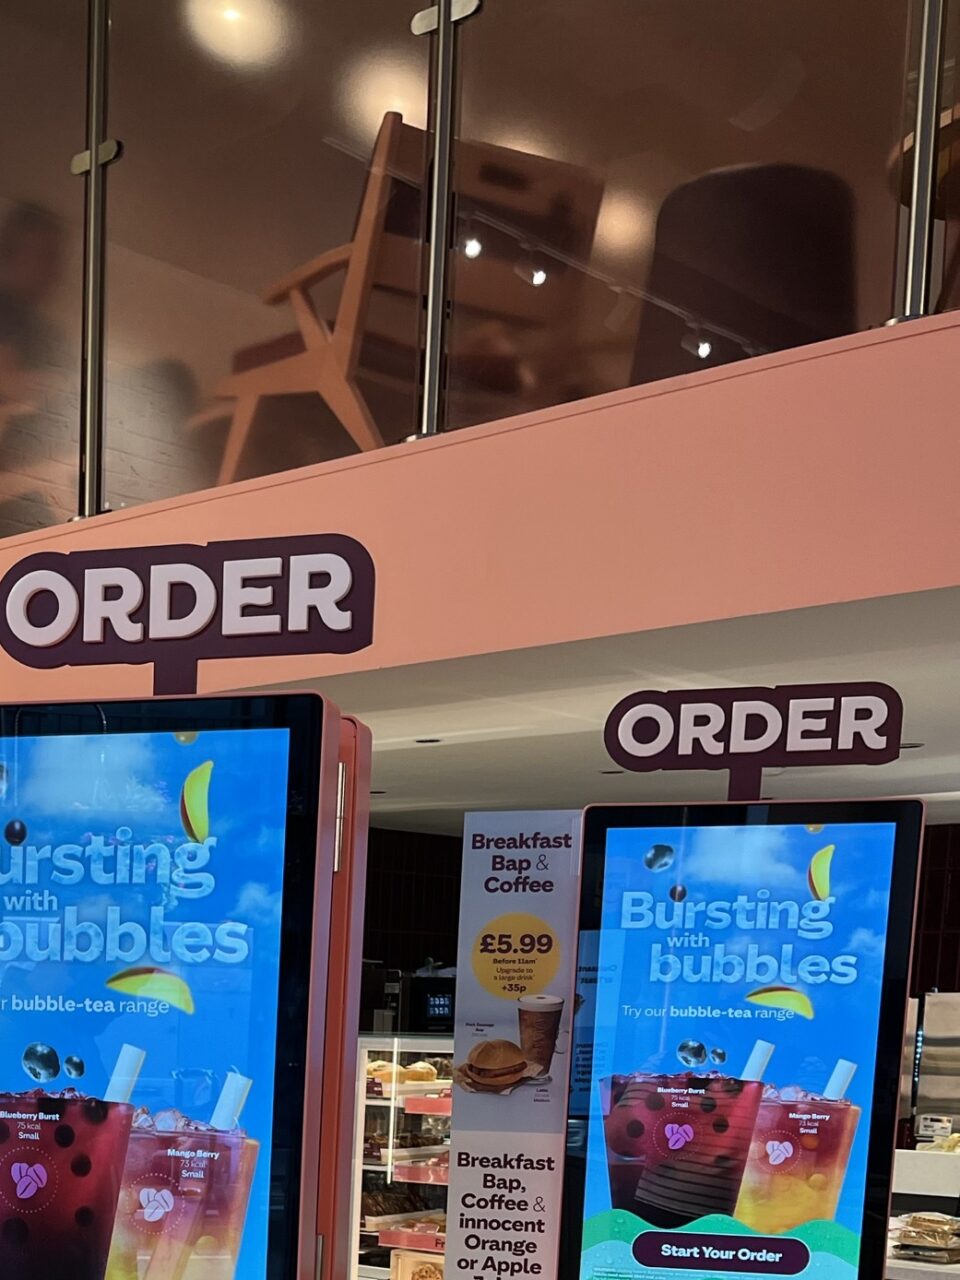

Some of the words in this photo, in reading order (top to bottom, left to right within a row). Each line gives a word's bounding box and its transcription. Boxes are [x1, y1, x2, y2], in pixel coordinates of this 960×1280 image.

[5, 552, 353, 648] ORDER
[617, 695, 889, 758] ORDER
[471, 832, 572, 850] Breakfast
[491, 855, 531, 874] Bap
[536, 854, 549, 871] &
[484, 876, 554, 893] Coffee
[3, 889, 59, 911] with
[620, 889, 836, 940] Bursting
[480, 934, 553, 954] £5.99
[667, 933, 710, 948] with
[649, 943, 858, 984] bubbles
[502, 983, 527, 993] +35p
[11, 995, 115, 1013] bubble-tea
[119, 998, 170, 1017] range
[622, 1005, 641, 1020] Try
[644, 1007, 668, 1017] our
[669, 1005, 752, 1019] bubble-tea
[755, 1008, 795, 1022] range
[0, 1111, 37, 1121] Blueberry
[38, 1112, 60, 1121] Burst
[26, 1122, 41, 1130] kcal
[18, 1132, 39, 1140] Small
[167, 1149, 196, 1158] Mango
[196, 1150, 220, 1160] Berry
[457, 1152, 555, 1171] Breakfast
[181, 1170, 204, 1178] Small
[483, 1173, 526, 1193] Bap,
[461, 1193, 528, 1211] Coffee
[533, 1196, 546, 1213] &
[459, 1213, 545, 1233] innocent
[464, 1234, 537, 1256] Orange
[661, 1243, 700, 1259] Start
[702, 1246, 736, 1261] Your
[737, 1248, 783, 1263] Order
[457, 1257, 478, 1271] or
[481, 1256, 542, 1276] Apple
